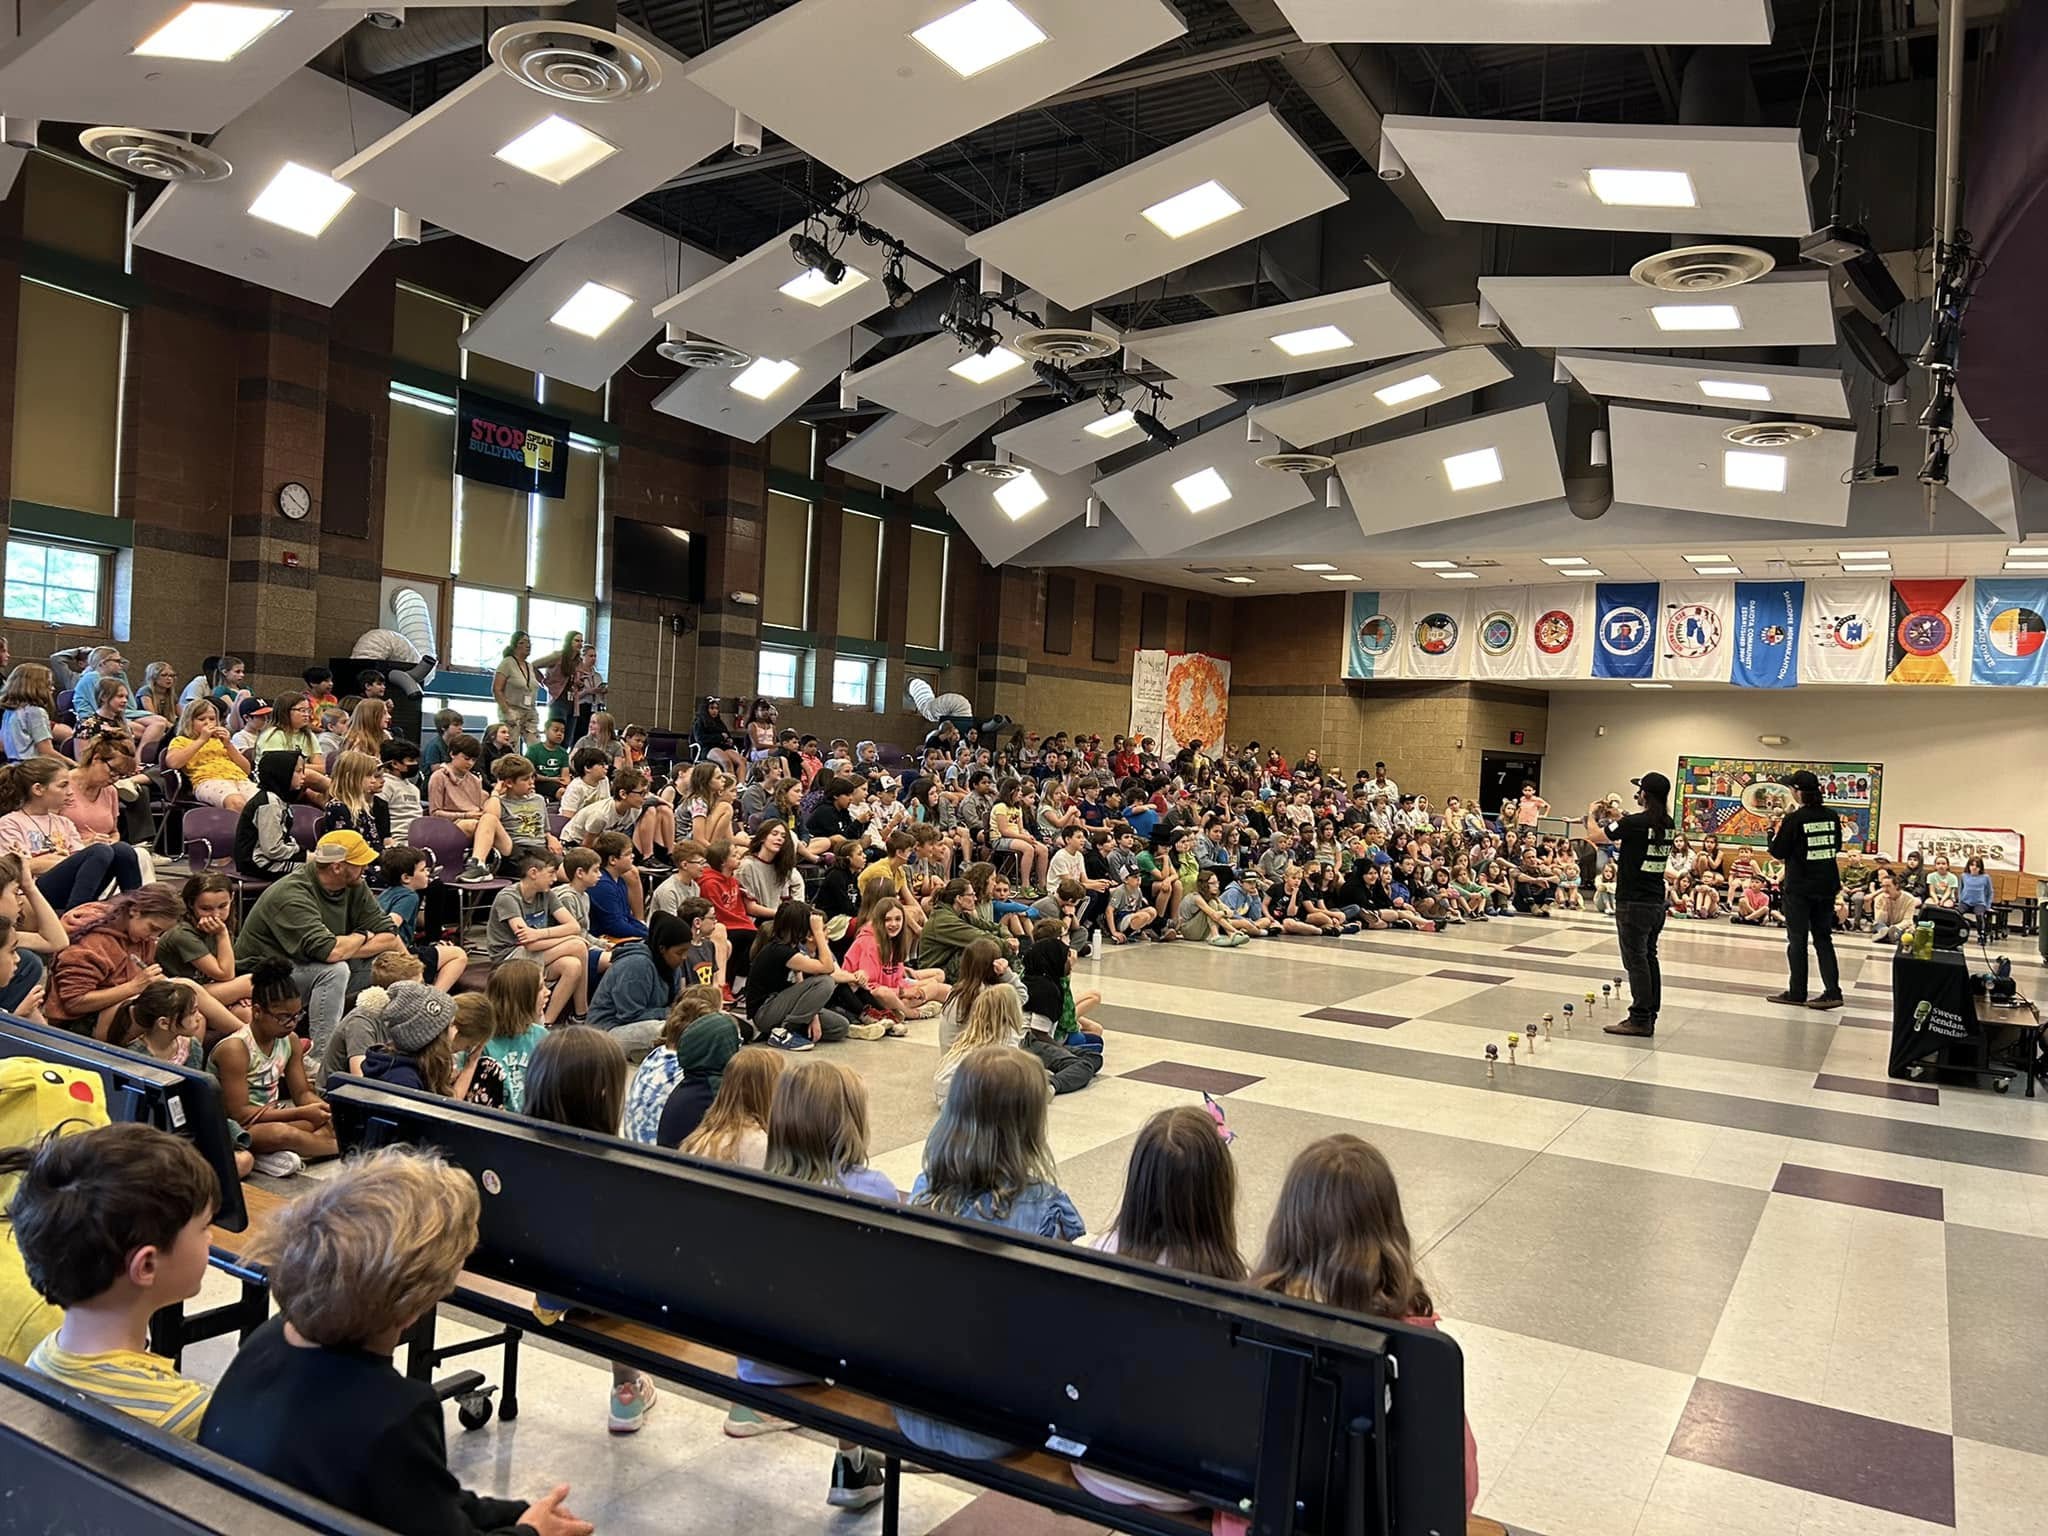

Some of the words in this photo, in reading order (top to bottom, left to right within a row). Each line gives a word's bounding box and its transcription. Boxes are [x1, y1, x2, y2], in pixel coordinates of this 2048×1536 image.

[471, 418, 525, 450] STOP
[527, 433, 553, 447] SPEAK
[469, 437, 524, 463] BULLYING
[526, 442, 538, 452] UP
[1748, 600, 1756, 627] DAKOTA
[1782, 590, 1794, 625] SHAKOPEE
[1745, 628, 1754, 670] COMMUNITY
[1980, 644, 1996, 668] OYATE
[1497, 771, 1507, 785] 7
[1918, 840, 2005, 861] HEROES
[1932, 1007, 1962, 1022] Sweets
